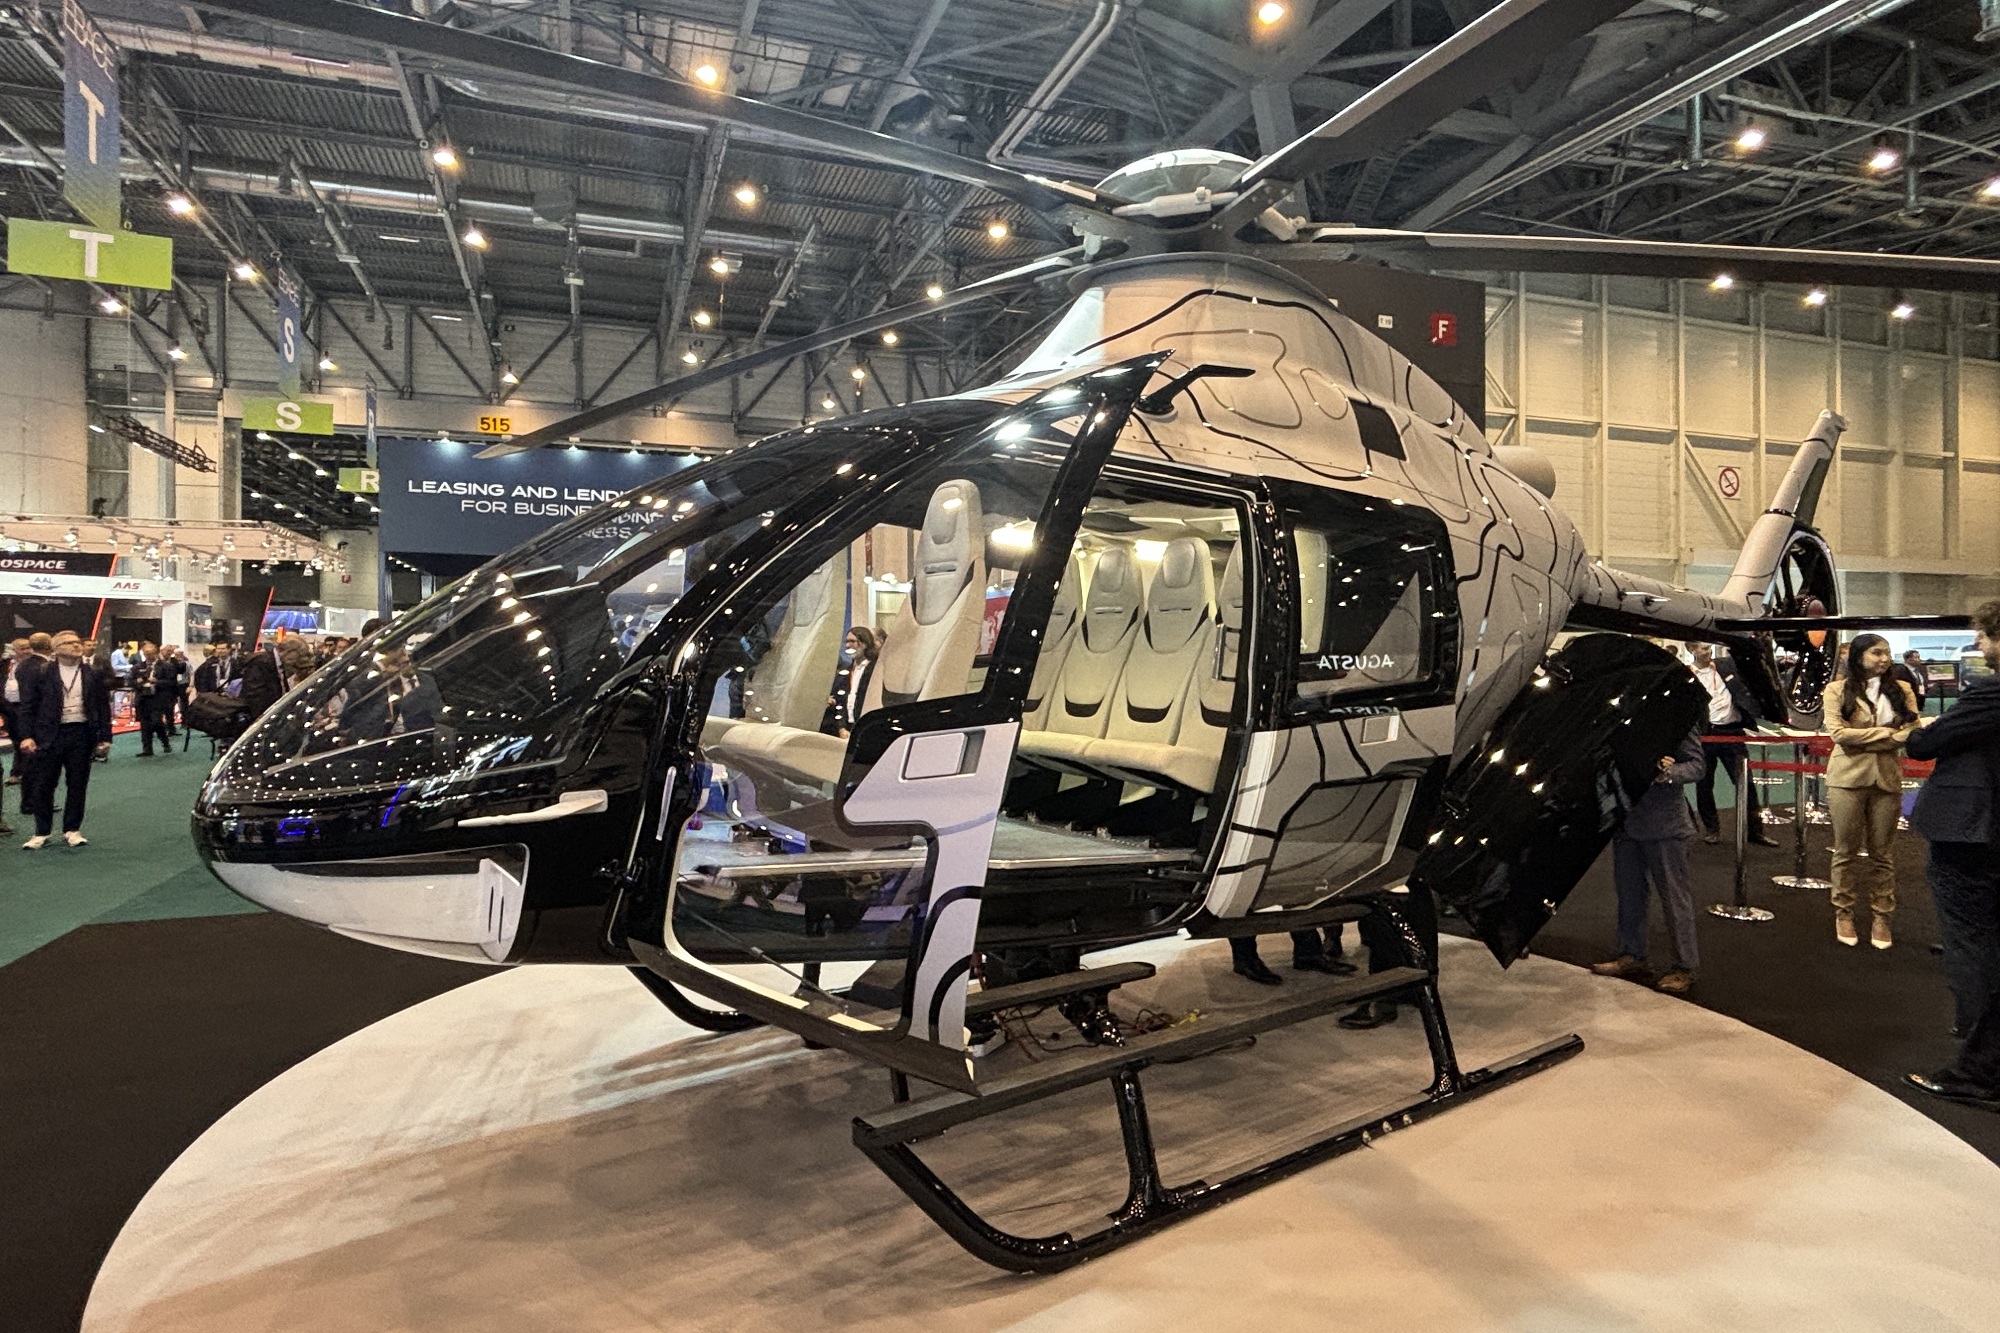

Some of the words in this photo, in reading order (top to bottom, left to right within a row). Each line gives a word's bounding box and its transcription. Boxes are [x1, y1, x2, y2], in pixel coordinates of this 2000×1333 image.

[79, 80, 105, 165] T
[69, 229, 115, 278] T
[1438, 319, 1449, 339] F
[284, 317, 295, 363] S
[275, 401, 302, 431] S
[480, 416, 510, 432] 515
[360, 470, 380, 491] R
[408, 480, 505, 497] LEASING
[511, 485, 557, 500] AND
[461, 500, 505, 514] FOR
[0, 559, 67, 570] OSPACE
[113, 582, 141, 590] AAS
